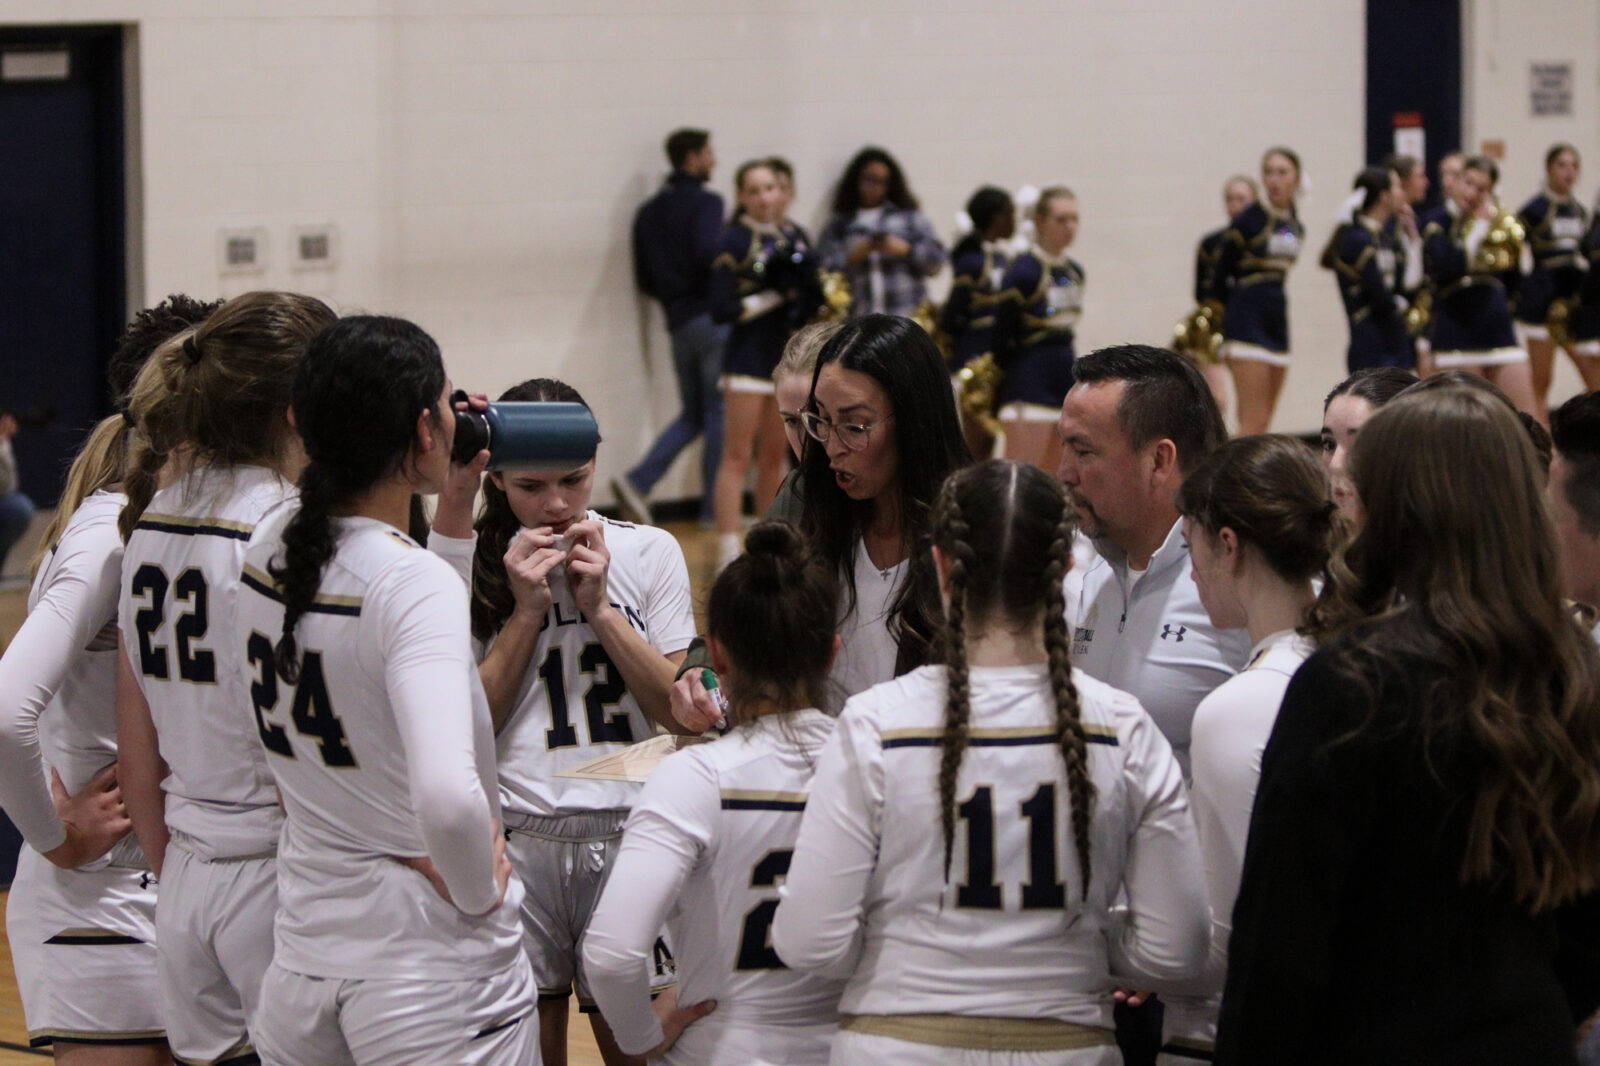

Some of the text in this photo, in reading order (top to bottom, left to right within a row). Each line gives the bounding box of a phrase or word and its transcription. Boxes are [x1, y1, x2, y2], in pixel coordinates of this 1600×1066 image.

[132, 562, 218, 685] 22
[247, 628, 360, 769] 24
[537, 641, 634, 752] 12
[955, 780, 1067, 912] 11
